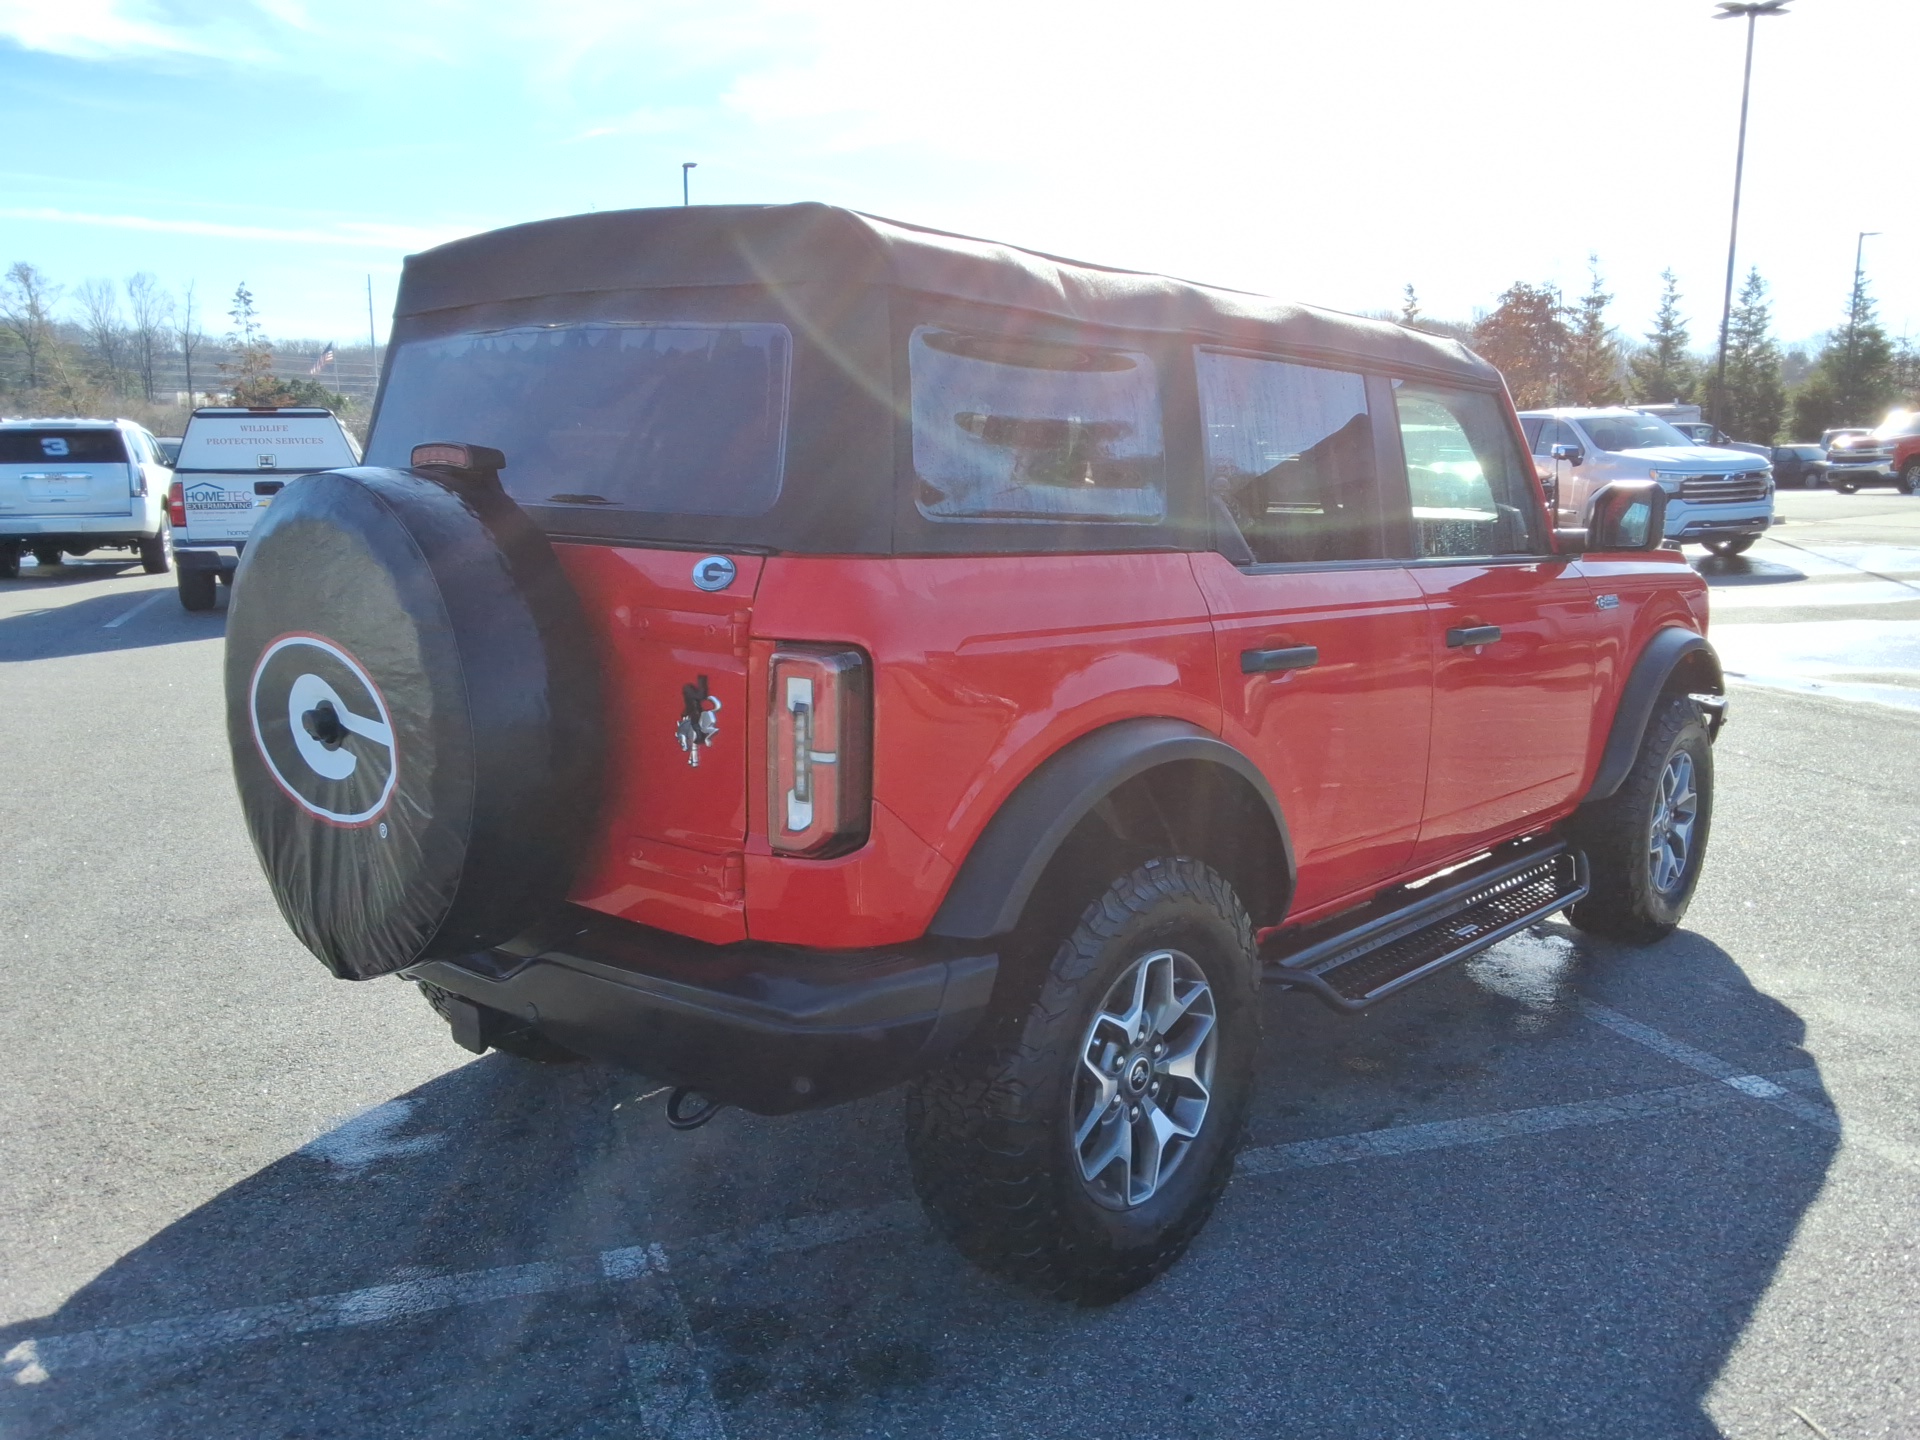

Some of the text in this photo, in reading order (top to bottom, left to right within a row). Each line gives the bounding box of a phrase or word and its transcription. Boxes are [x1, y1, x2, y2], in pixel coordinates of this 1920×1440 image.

[206, 437, 324, 445] PROTECTION SERVICES
[40, 437, 70, 456] 3
[185, 491, 252, 502] HOMETEC
[186, 502, 252, 510] EXTERMINATING
